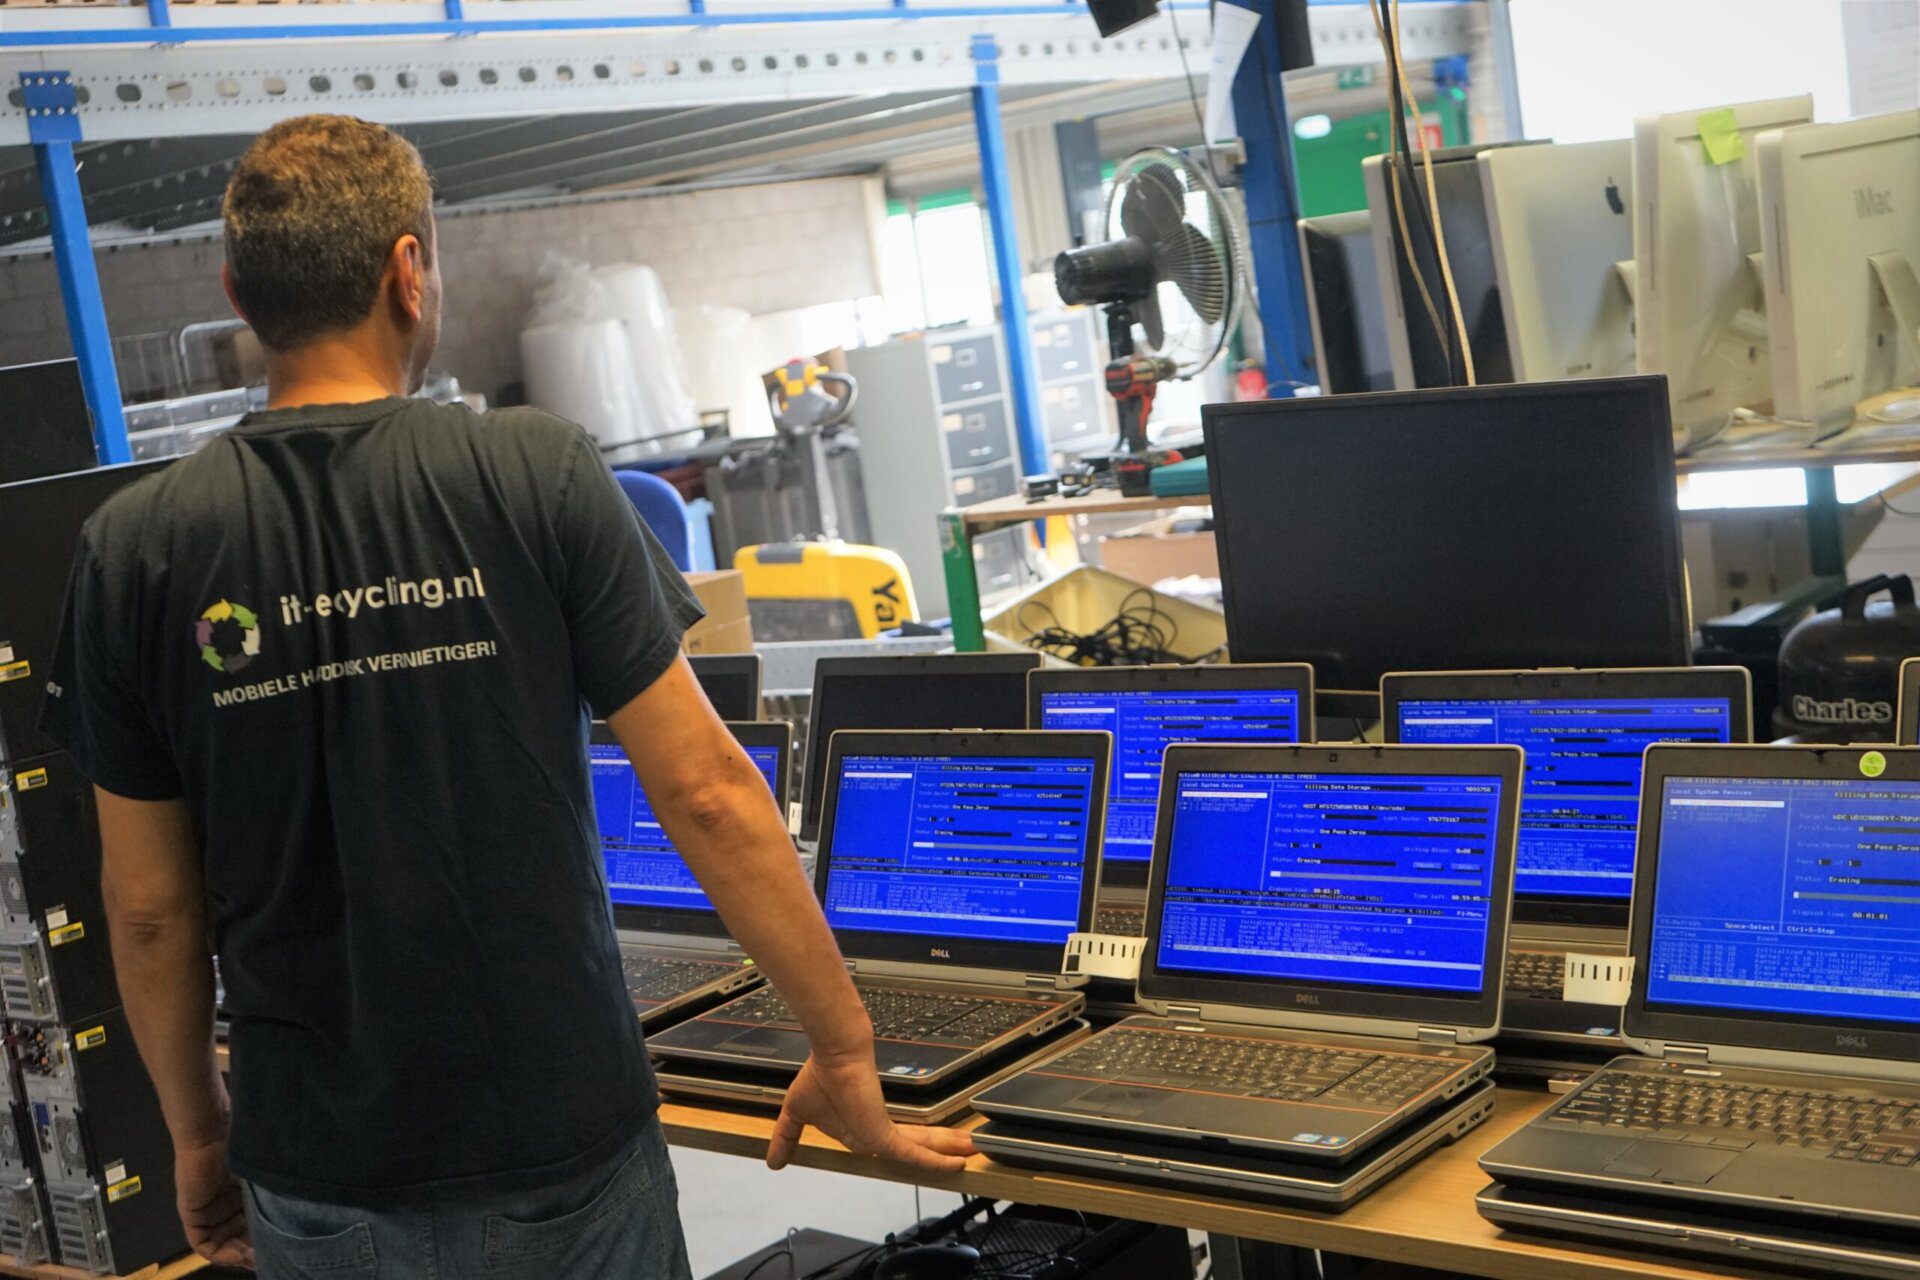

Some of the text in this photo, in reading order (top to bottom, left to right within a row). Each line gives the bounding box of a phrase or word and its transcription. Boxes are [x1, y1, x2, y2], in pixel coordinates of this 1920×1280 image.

[1853, 186, 1893, 219] iMac
[872, 578, 900, 631] Ya
[212, 675, 298, 708] MOBIELE
[366, 641, 497, 673] VERNIETIGER!
[1793, 695, 1893, 724] Charles
[1829, 876, 1861, 885] Erasing
